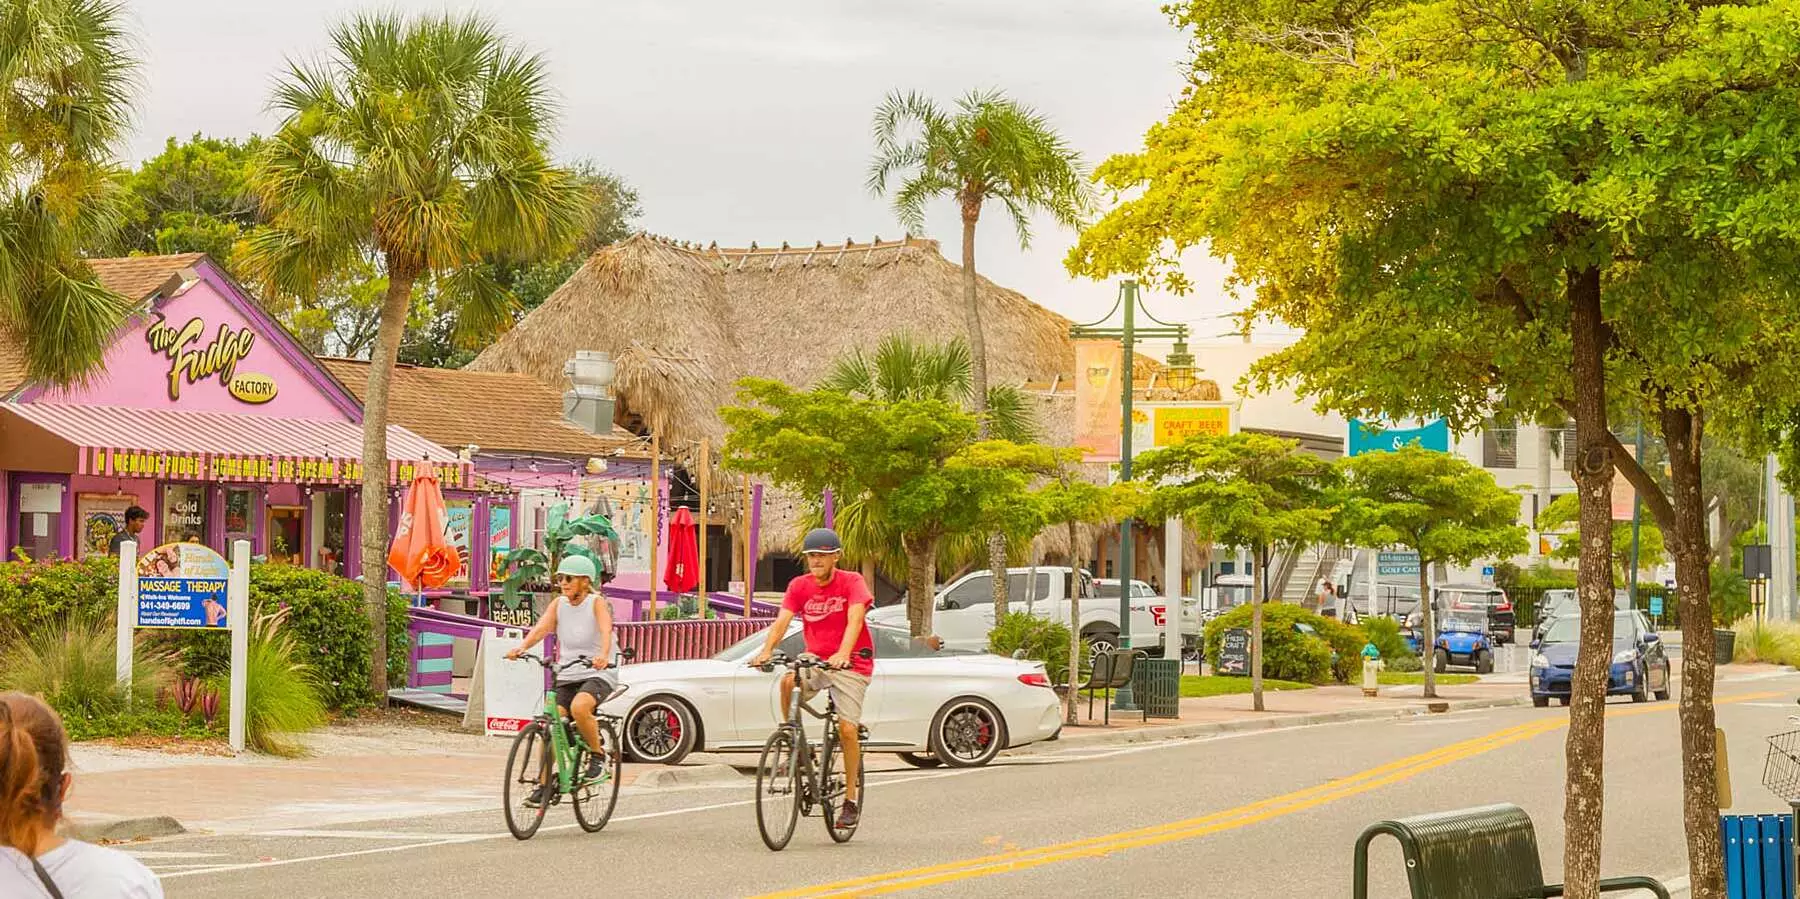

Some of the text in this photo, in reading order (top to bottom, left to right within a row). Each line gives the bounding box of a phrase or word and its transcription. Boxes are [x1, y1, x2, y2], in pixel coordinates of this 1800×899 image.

[148, 318, 178, 352] The
[168, 317, 255, 400] Fudge
[234, 379, 273, 395] FACTORY
[1163, 420, 1224, 431] CRAFT BEER
[1392, 436, 1403, 450] &
[165, 455, 200, 475] FUDGE
[277, 459, 295, 478] ICE
[300, 461, 333, 479] CREAM
[175, 501, 197, 513] Cold
[171, 513, 202, 525] Drinks
[140, 580, 226, 594] MASSAGE THERAPY
[489, 718, 520, 731] Coca-Cola
